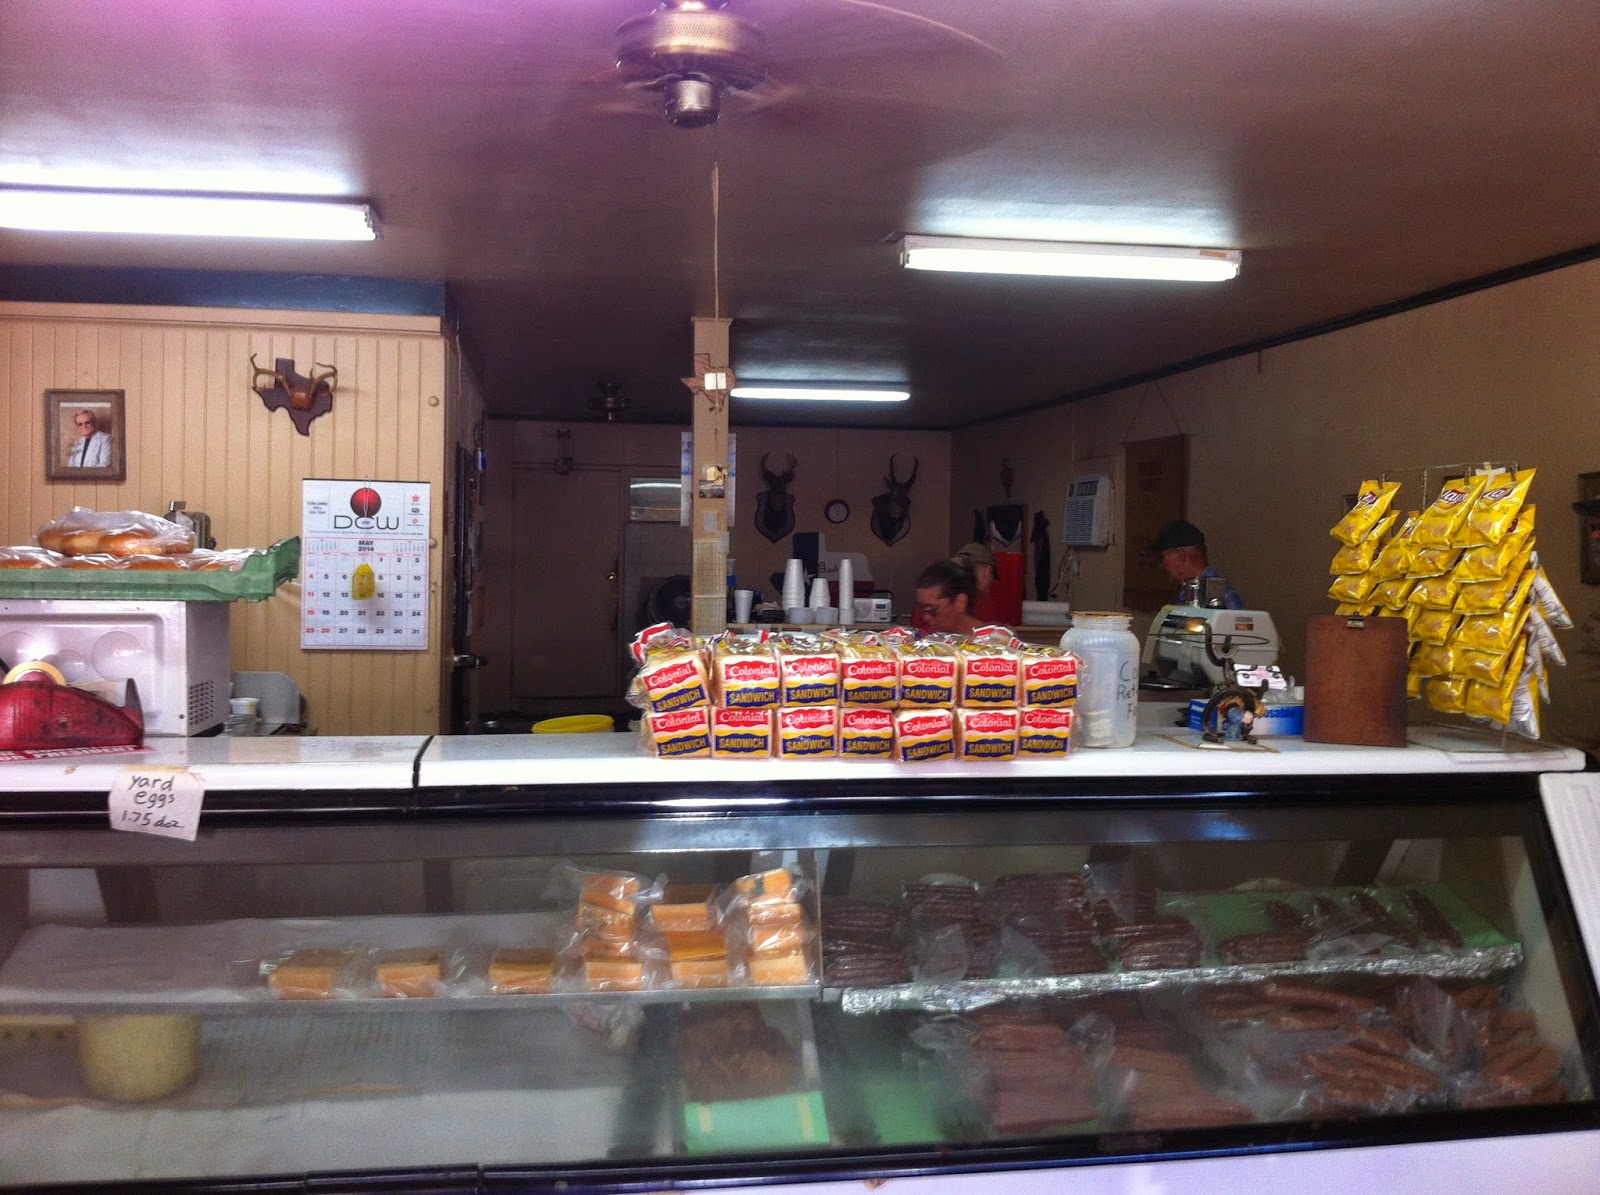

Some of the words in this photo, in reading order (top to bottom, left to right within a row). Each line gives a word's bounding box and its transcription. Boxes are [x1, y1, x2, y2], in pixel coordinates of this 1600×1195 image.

[333, 515, 400, 531] DCW
[728, 665, 776, 678] Colonial
[789, 660, 834, 673] Colonial
[847, 661, 893, 676] Colonial
[906, 661, 951, 675] Colonial
[971, 660, 1014, 673] Colonial
[1030, 661, 1074, 677] Colonial
[648, 666, 693, 688] Colonial
[728, 691, 776, 704] SANDWICH
[789, 688, 835, 700] SANDWICH
[847, 690, 893, 701] SANDWICH
[905, 688, 949, 700] SANDWICH
[968, 687, 1012, 699] SANDWICH
[1031, 688, 1074, 702] SANDWICH
[656, 692, 702, 712] SANDWICH
[656, 713, 703, 731] Colonial
[720, 711, 766, 723] Colonial
[785, 712, 830, 726] Colonial
[846, 713, 891, 727] Colonial
[969, 715, 1013, 728] Colonial
[1024, 712, 1067, 724] Colonial
[903, 716, 949, 733] Colonial
[660, 738, 707, 754] SANDWICH
[719, 738, 765, 749] SANDWICH
[785, 740, 831, 752] SANDWICH
[845, 739, 891, 751] SANDWICH
[968, 742, 1012, 754] SANDWICH
[1021, 738, 1064, 750] SANDWICH
[906, 743, 950, 759] SANDWICH
[128, 774, 175, 792] yard
[133, 790, 176, 809] eggs
[121, 810, 153, 827] 1.75
